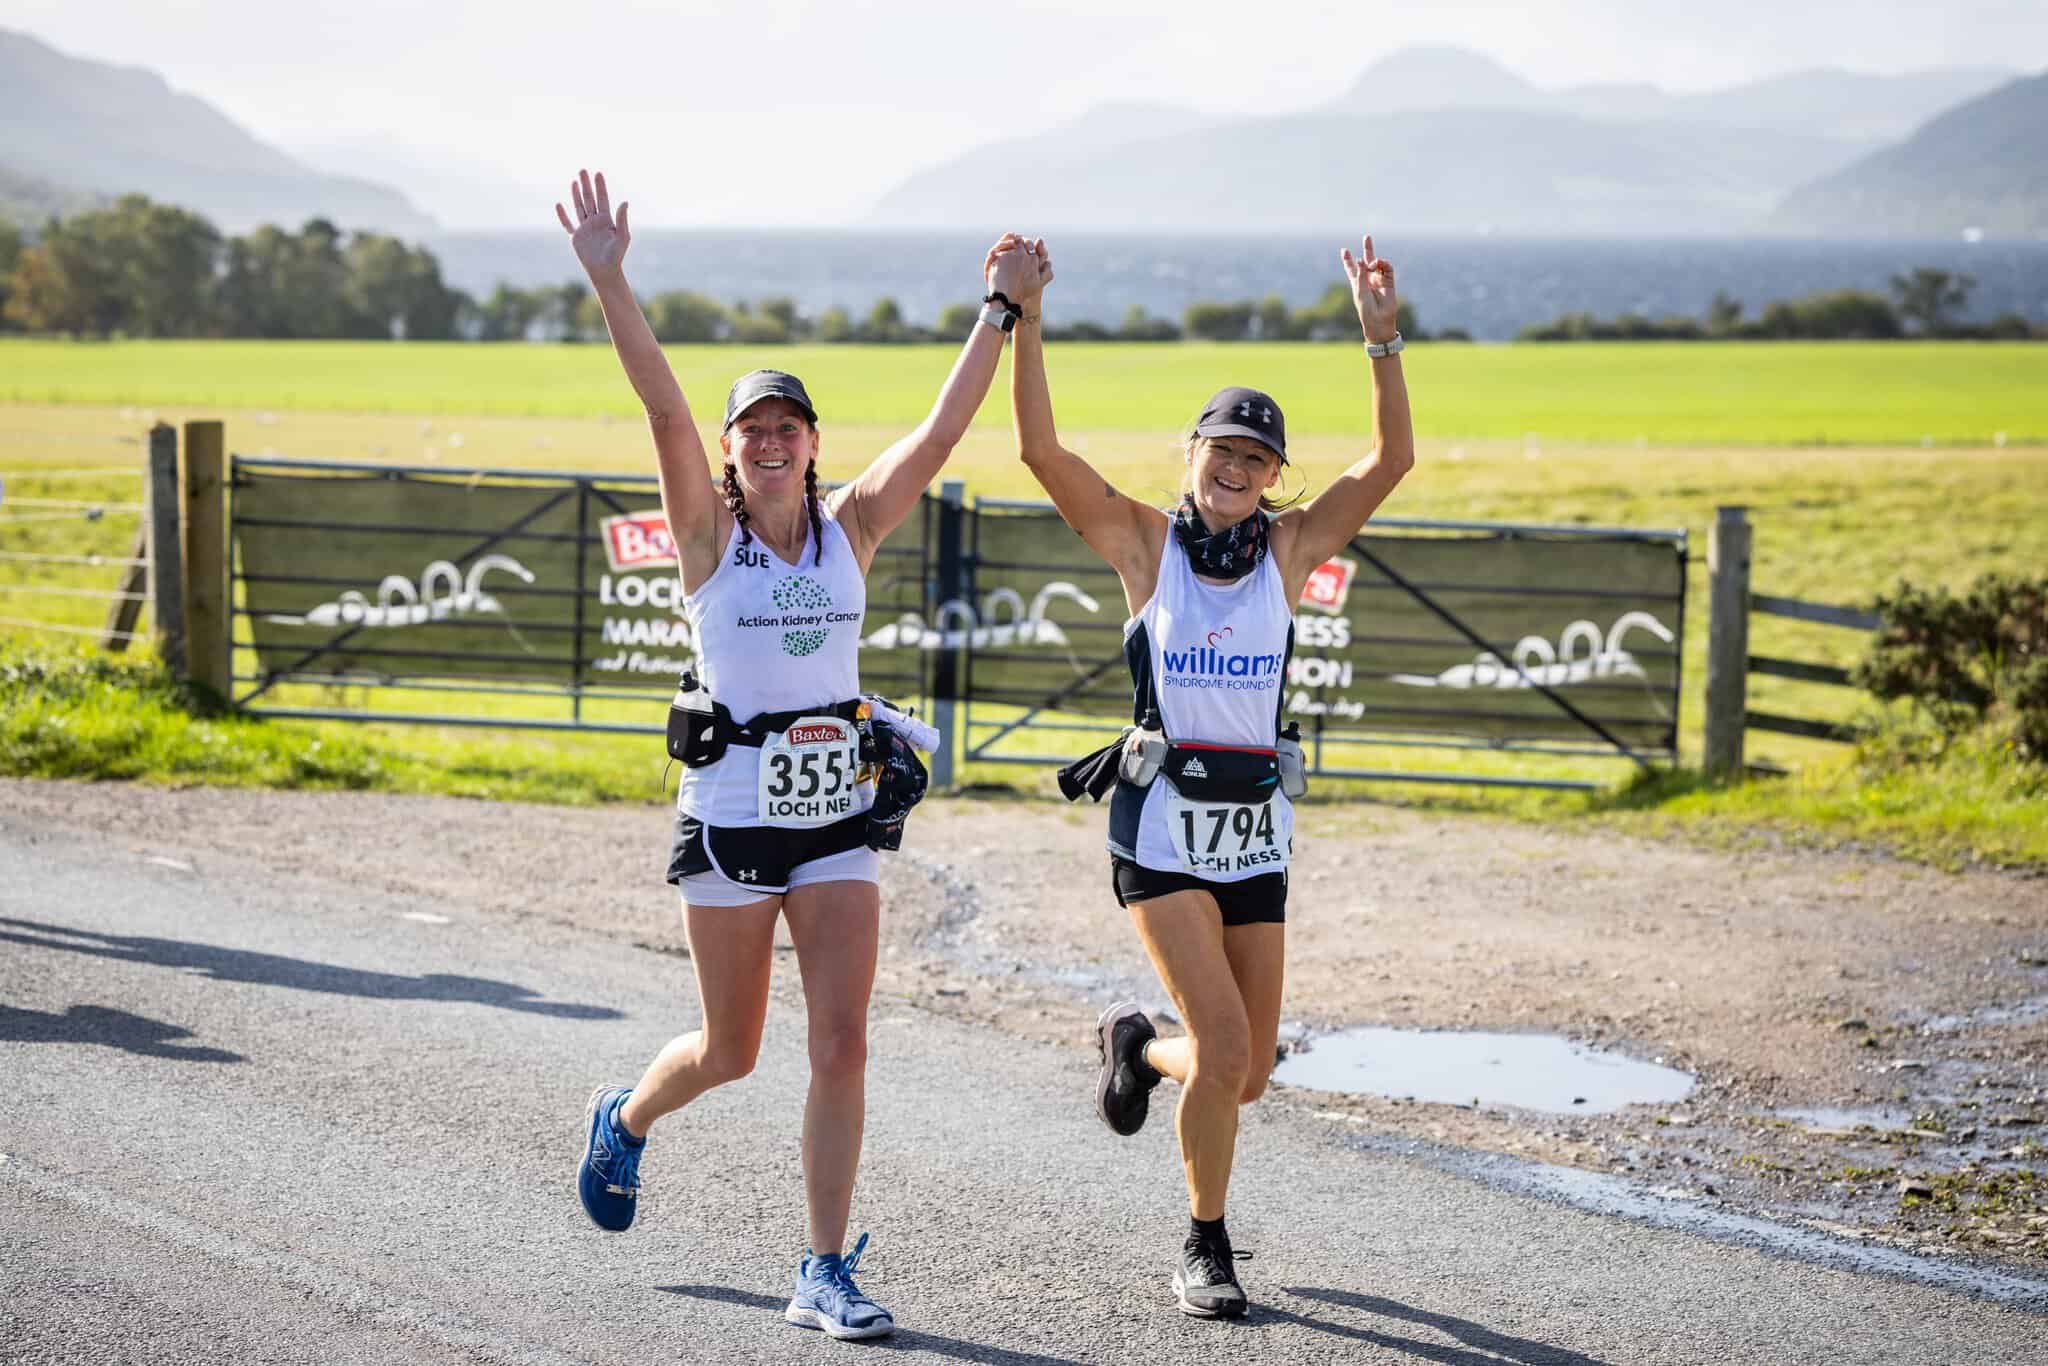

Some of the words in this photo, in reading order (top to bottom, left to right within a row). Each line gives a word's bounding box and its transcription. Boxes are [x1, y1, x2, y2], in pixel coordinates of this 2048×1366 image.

[617, 522, 676, 562] Ba
[734, 547, 769, 569] SUE
[737, 616, 778, 627] Action
[781, 615, 822, 627] Kidney
[1164, 675, 1223, 689] SYNDROME
[769, 801, 820, 817] LOCH
[1180, 803, 1275, 853] 1794
[1237, 849, 1281, 871] NESS
